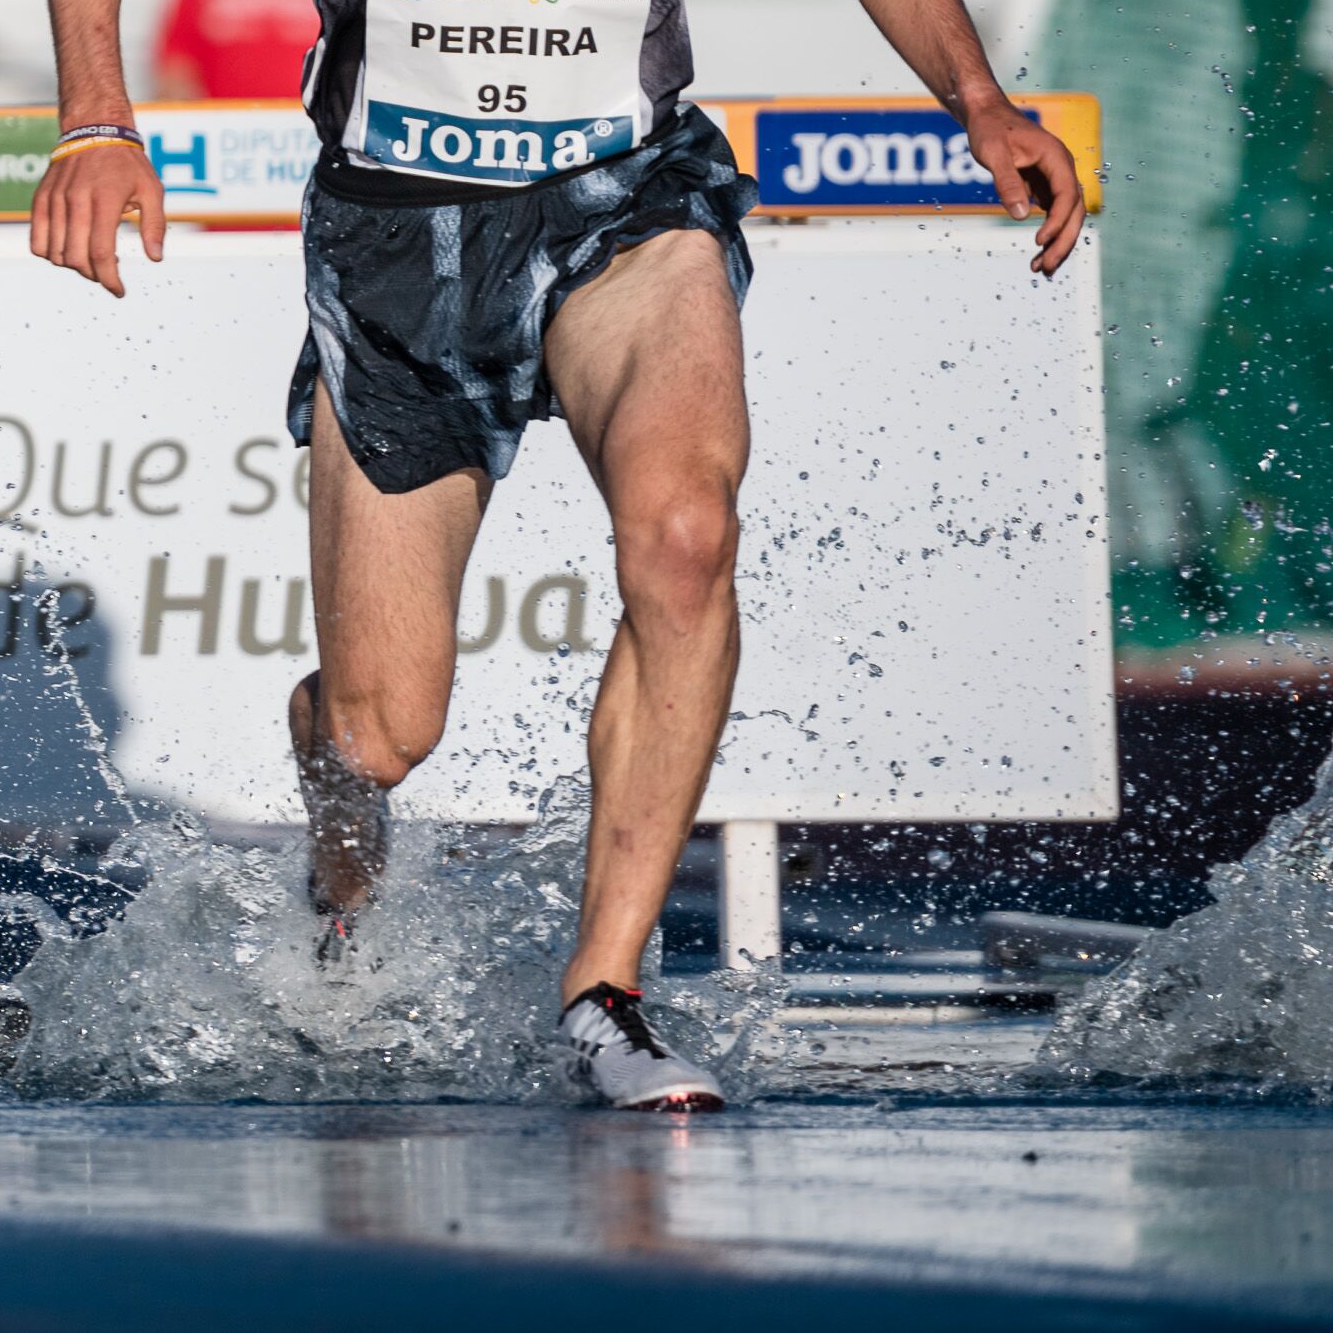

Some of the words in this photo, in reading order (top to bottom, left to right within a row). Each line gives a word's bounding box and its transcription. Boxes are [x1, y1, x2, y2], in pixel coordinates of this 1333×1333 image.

[411, 22, 599, 57] PEREIRA
[477, 83, 528, 113] 95
[219, 158, 255, 183] DE
[138, 553, 595, 658] Huva
